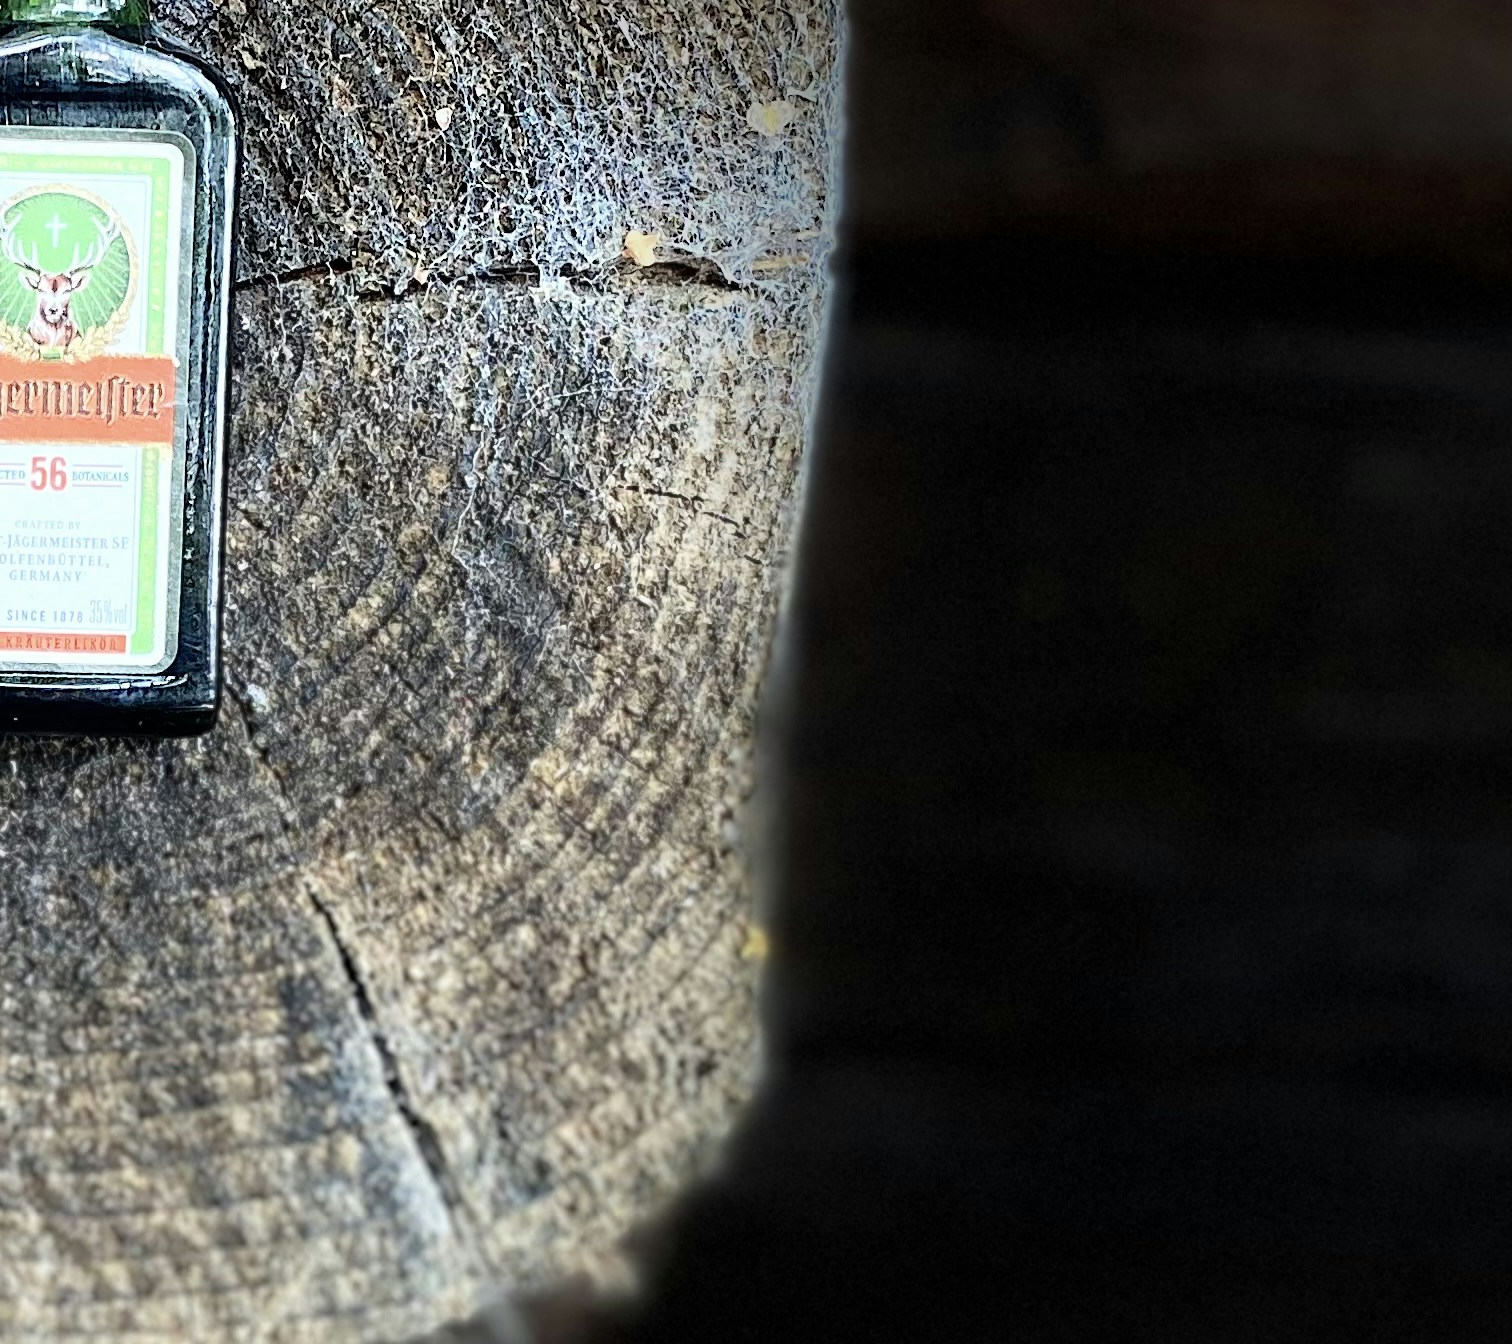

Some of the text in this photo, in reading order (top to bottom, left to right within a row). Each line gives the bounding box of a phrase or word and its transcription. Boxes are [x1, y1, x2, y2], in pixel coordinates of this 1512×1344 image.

[30, 456, 67, 491] 56
[72, 471, 129, 482] BOTANICALS
[14, 520, 81, 530] CRAFTED BY
[112, 536, 130, 550] SE
[9, 569, 83, 582] GERMANY
[6, 609, 83, 623] SINCE 1878
